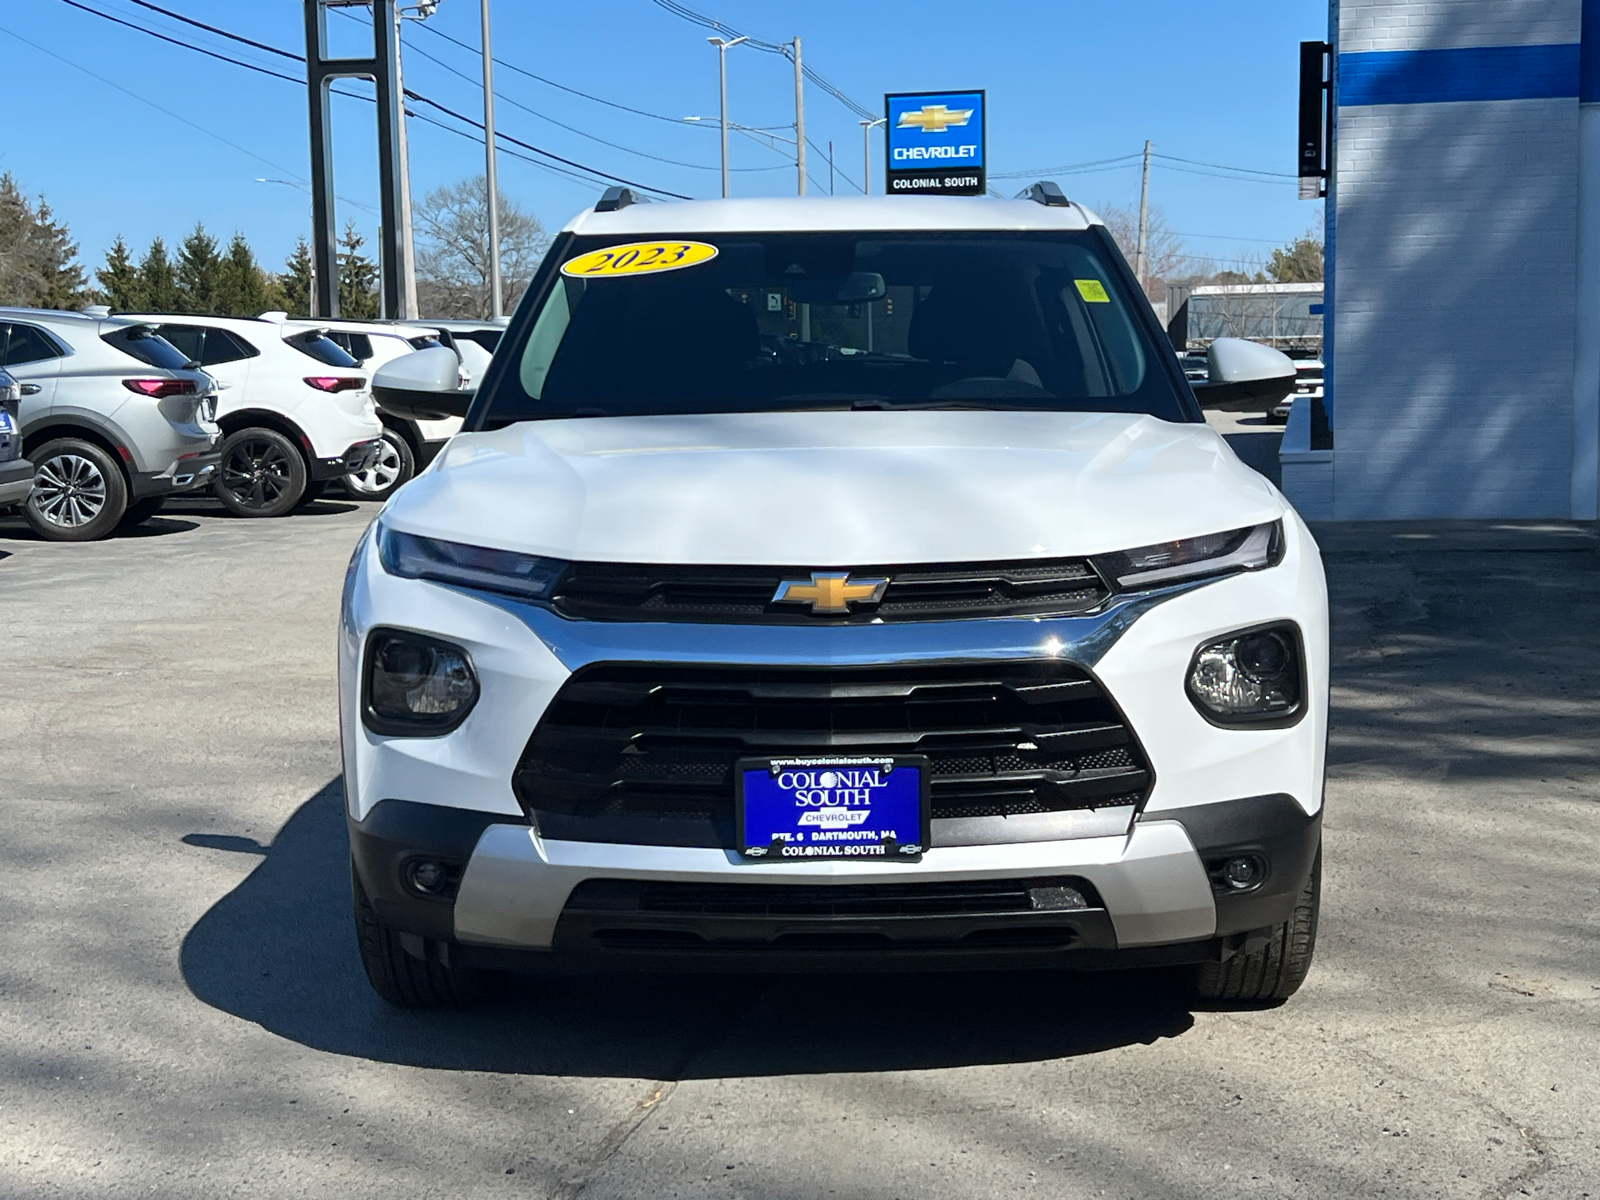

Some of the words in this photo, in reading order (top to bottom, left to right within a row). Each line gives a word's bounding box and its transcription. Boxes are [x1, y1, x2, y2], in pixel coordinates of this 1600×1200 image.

[893, 145, 977, 160] CHEVROLET
[893, 179, 942, 189] COLONIAL
[944, 177, 978, 187] SOUTH
[584, 245, 691, 273] 2023
[770, 757, 894, 766] www.buycolonialsouth.com
[778, 770, 888, 790] COLONIAL
[795, 789, 871, 807] SOUTH
[805, 813, 863, 822] CHEVROLET
[796, 832, 804, 841] 6
[811, 830, 879, 841] DARTMOUTH,
[781, 846, 844, 856] COLONIAL
[844, 845, 886, 855] SOUTH
